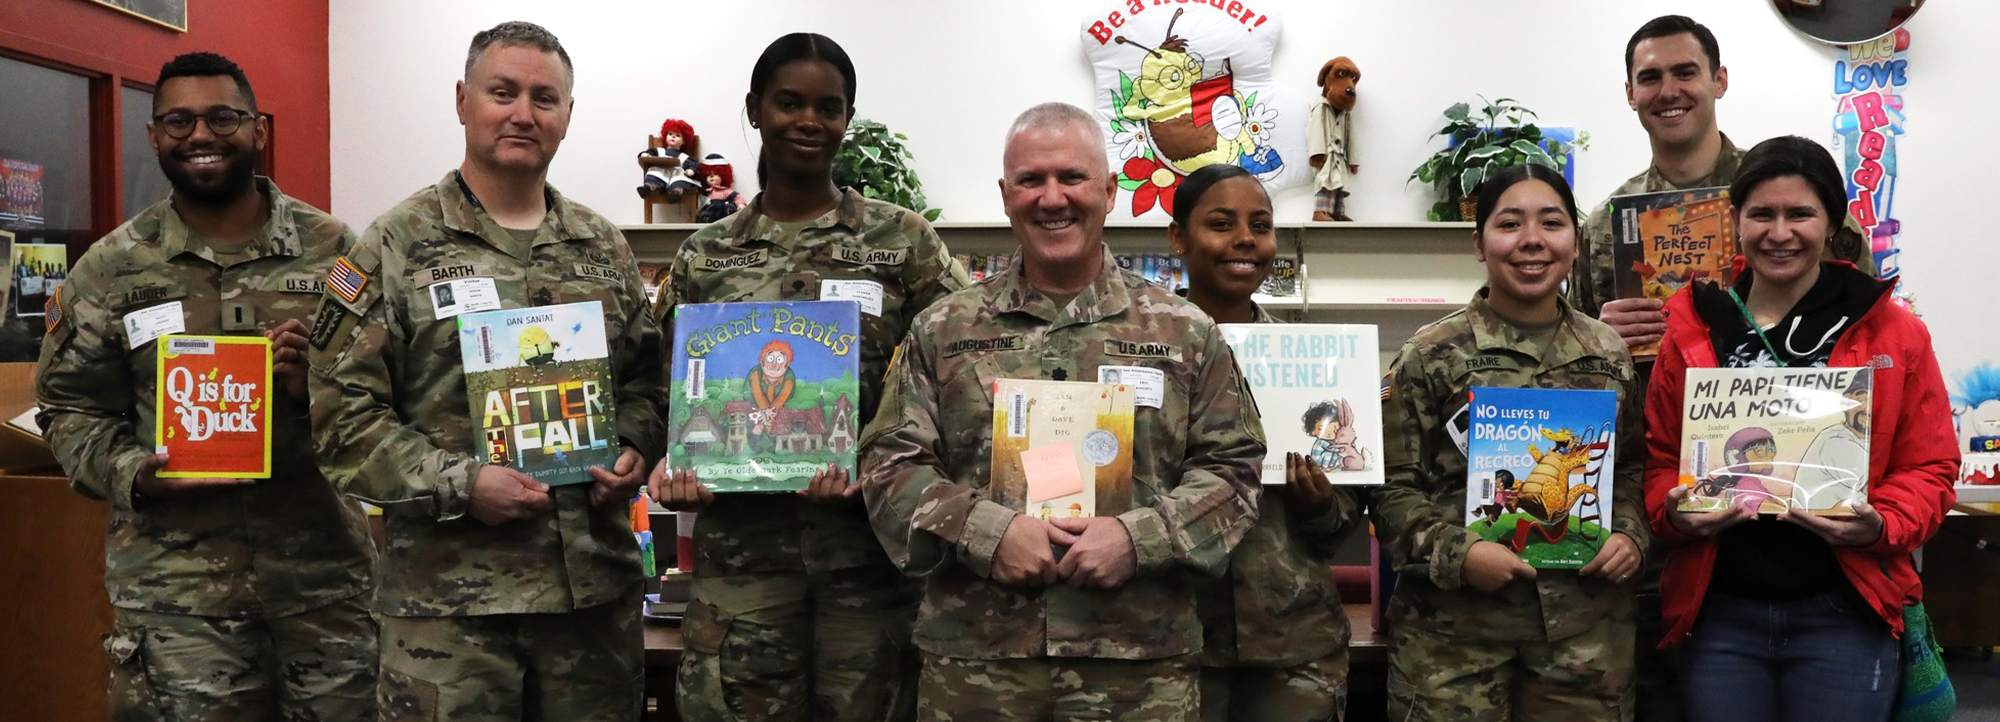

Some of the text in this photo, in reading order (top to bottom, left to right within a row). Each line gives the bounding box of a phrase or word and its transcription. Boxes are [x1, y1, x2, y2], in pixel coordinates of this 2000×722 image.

[1088, 0, 1268, 46] Be a der!
[1834, 59, 1908, 95] LOVE
[1668, 223, 1691, 236] The
[705, 253, 761, 269] DOMINGUEZ
[841, 249, 899, 264] U.S. ARMY
[431, 264, 475, 281] BARTH
[581, 265, 602, 277] U.S.
[124, 286, 167, 304] LAUDER
[506, 313, 554, 326] DAN SANTAT
[686, 306, 857, 358] Giant Pants
[951, 338, 1015, 353] AUGUSTINE
[1280, 334, 1359, 359] RABBIT
[1465, 356, 1500, 370] FRAIRE
[1245, 363, 1339, 388] ISTENED
[166, 366, 257, 408] Q is for
[1694, 371, 1848, 399] MI PAPI TIENE
[483, 381, 605, 428] AFTER
[1475, 404, 1551, 421] NO LLEVES TU
[1688, 401, 1737, 421] UNA
[187, 403, 258, 442] Duck
[1707, 424, 1730, 432] Isabel
[1777, 425, 1816, 435] Zeke Peña
[1475, 421, 1544, 443] DRAGÓN
[513, 415, 609, 470] FALL
[1497, 444, 1509, 453] AL
[708, 467, 719, 476] By
[723, 466, 733, 474] Ye
[1474, 455, 1535, 470] RECREO
